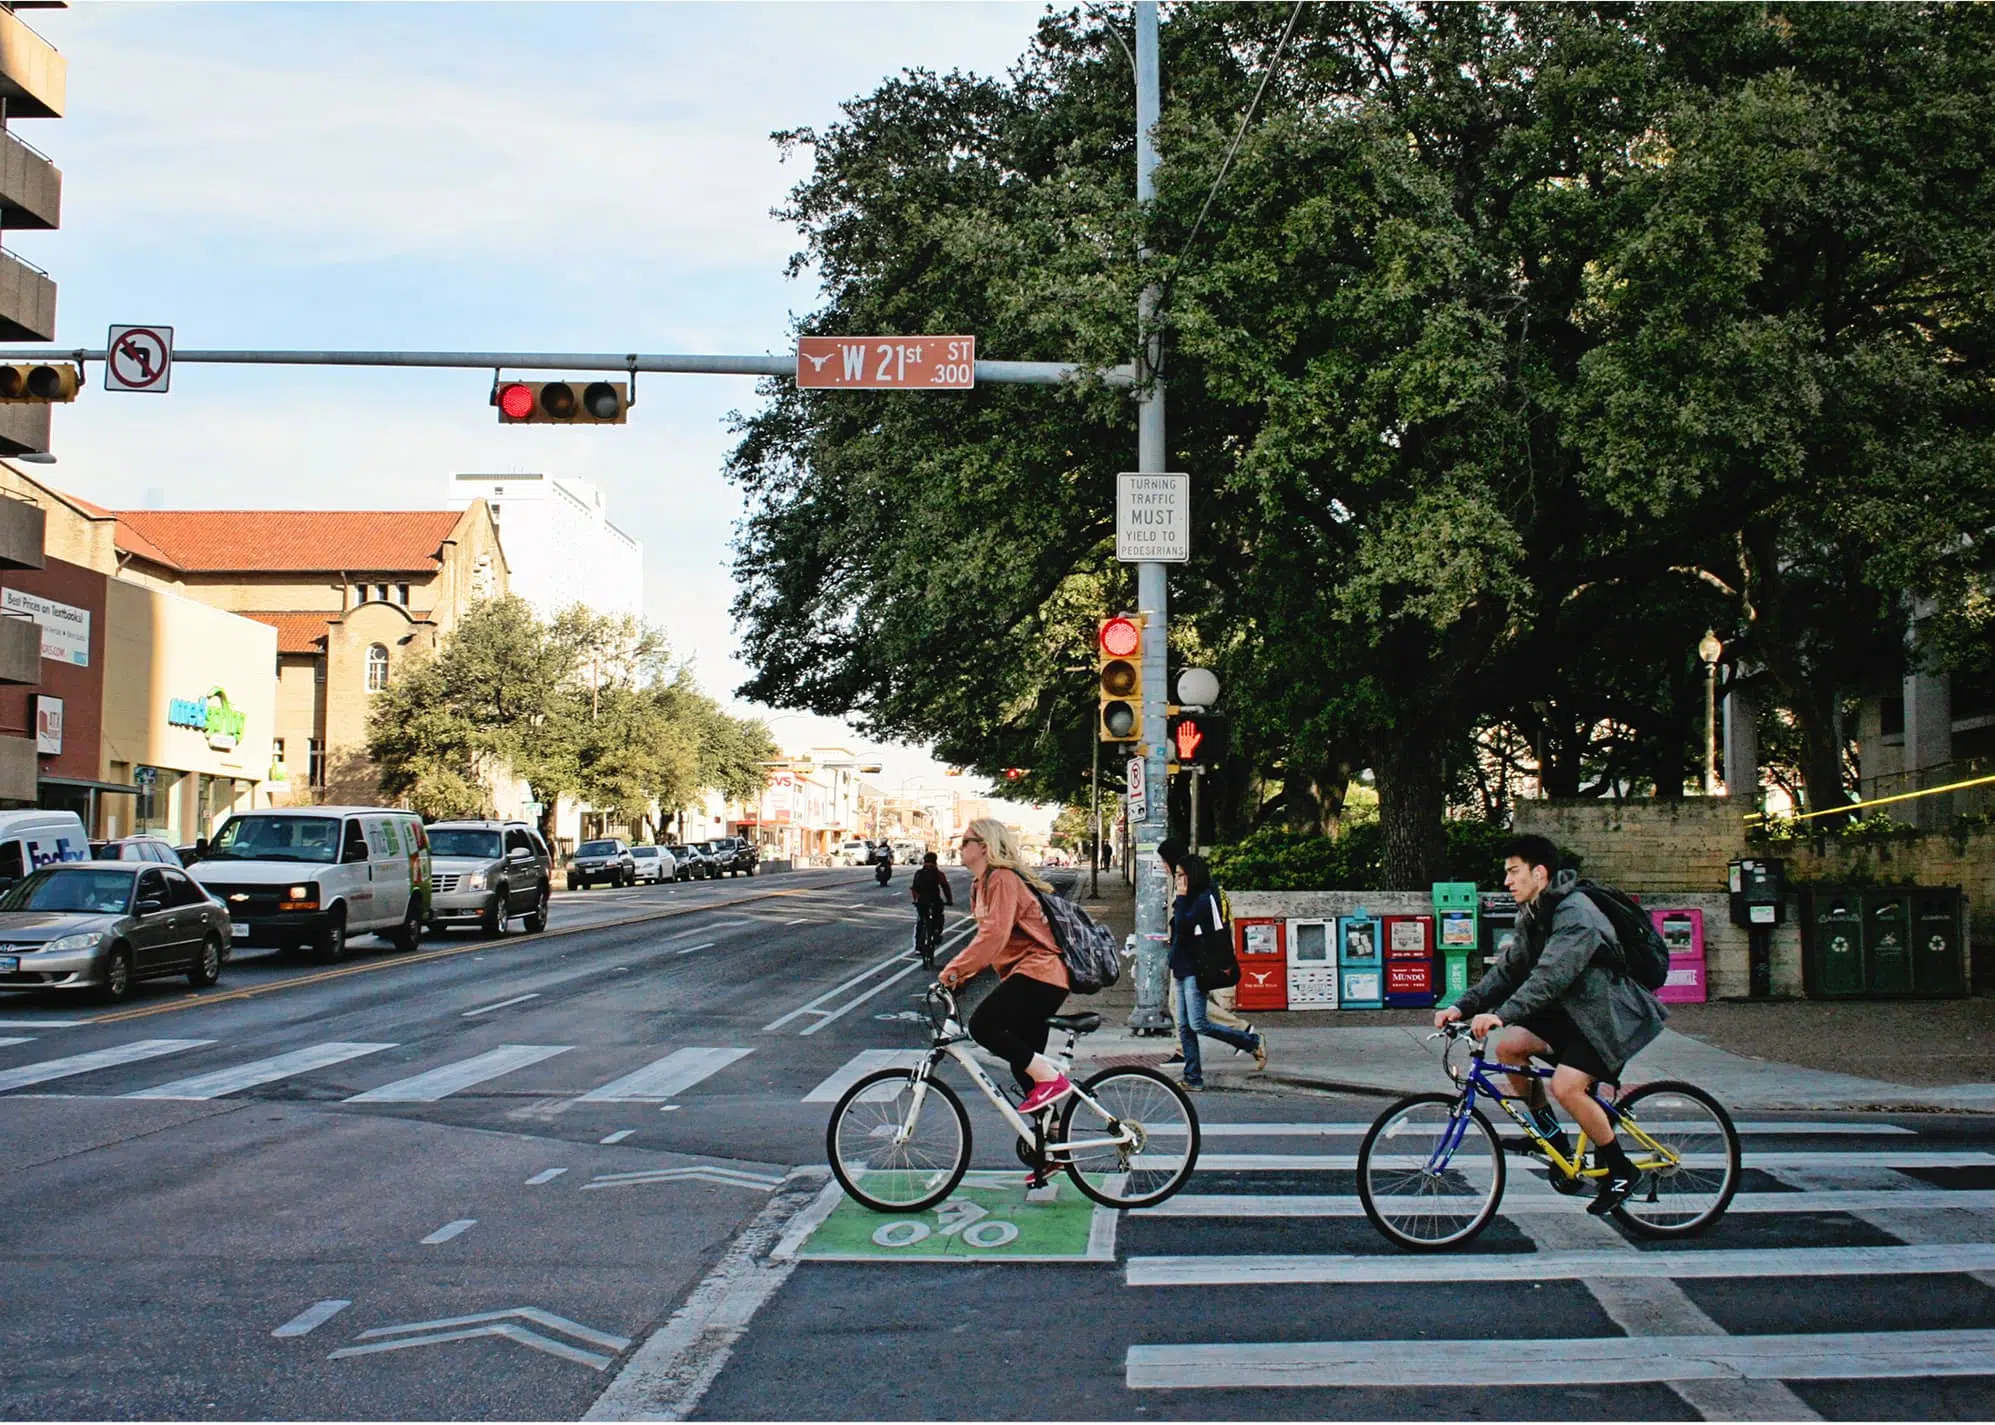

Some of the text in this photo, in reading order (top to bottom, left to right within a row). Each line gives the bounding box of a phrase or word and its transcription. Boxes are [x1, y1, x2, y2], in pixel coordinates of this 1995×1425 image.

[842, 341, 970, 381] W 21st ST
[935, 363, 970, 384] 300
[1129, 478, 1176, 490] TURNING
[1130, 493, 1176, 505] TRAFFIC
[1131, 509, 1174, 525] MUST
[1126, 530, 1176, 542] YIELD TO
[1121, 545, 1184, 556] PEDESTRIANS
[22, 596, 41, 613] Prices
[41, 605, 51, 615] on
[1392, 973, 1425, 981] MUNDO
